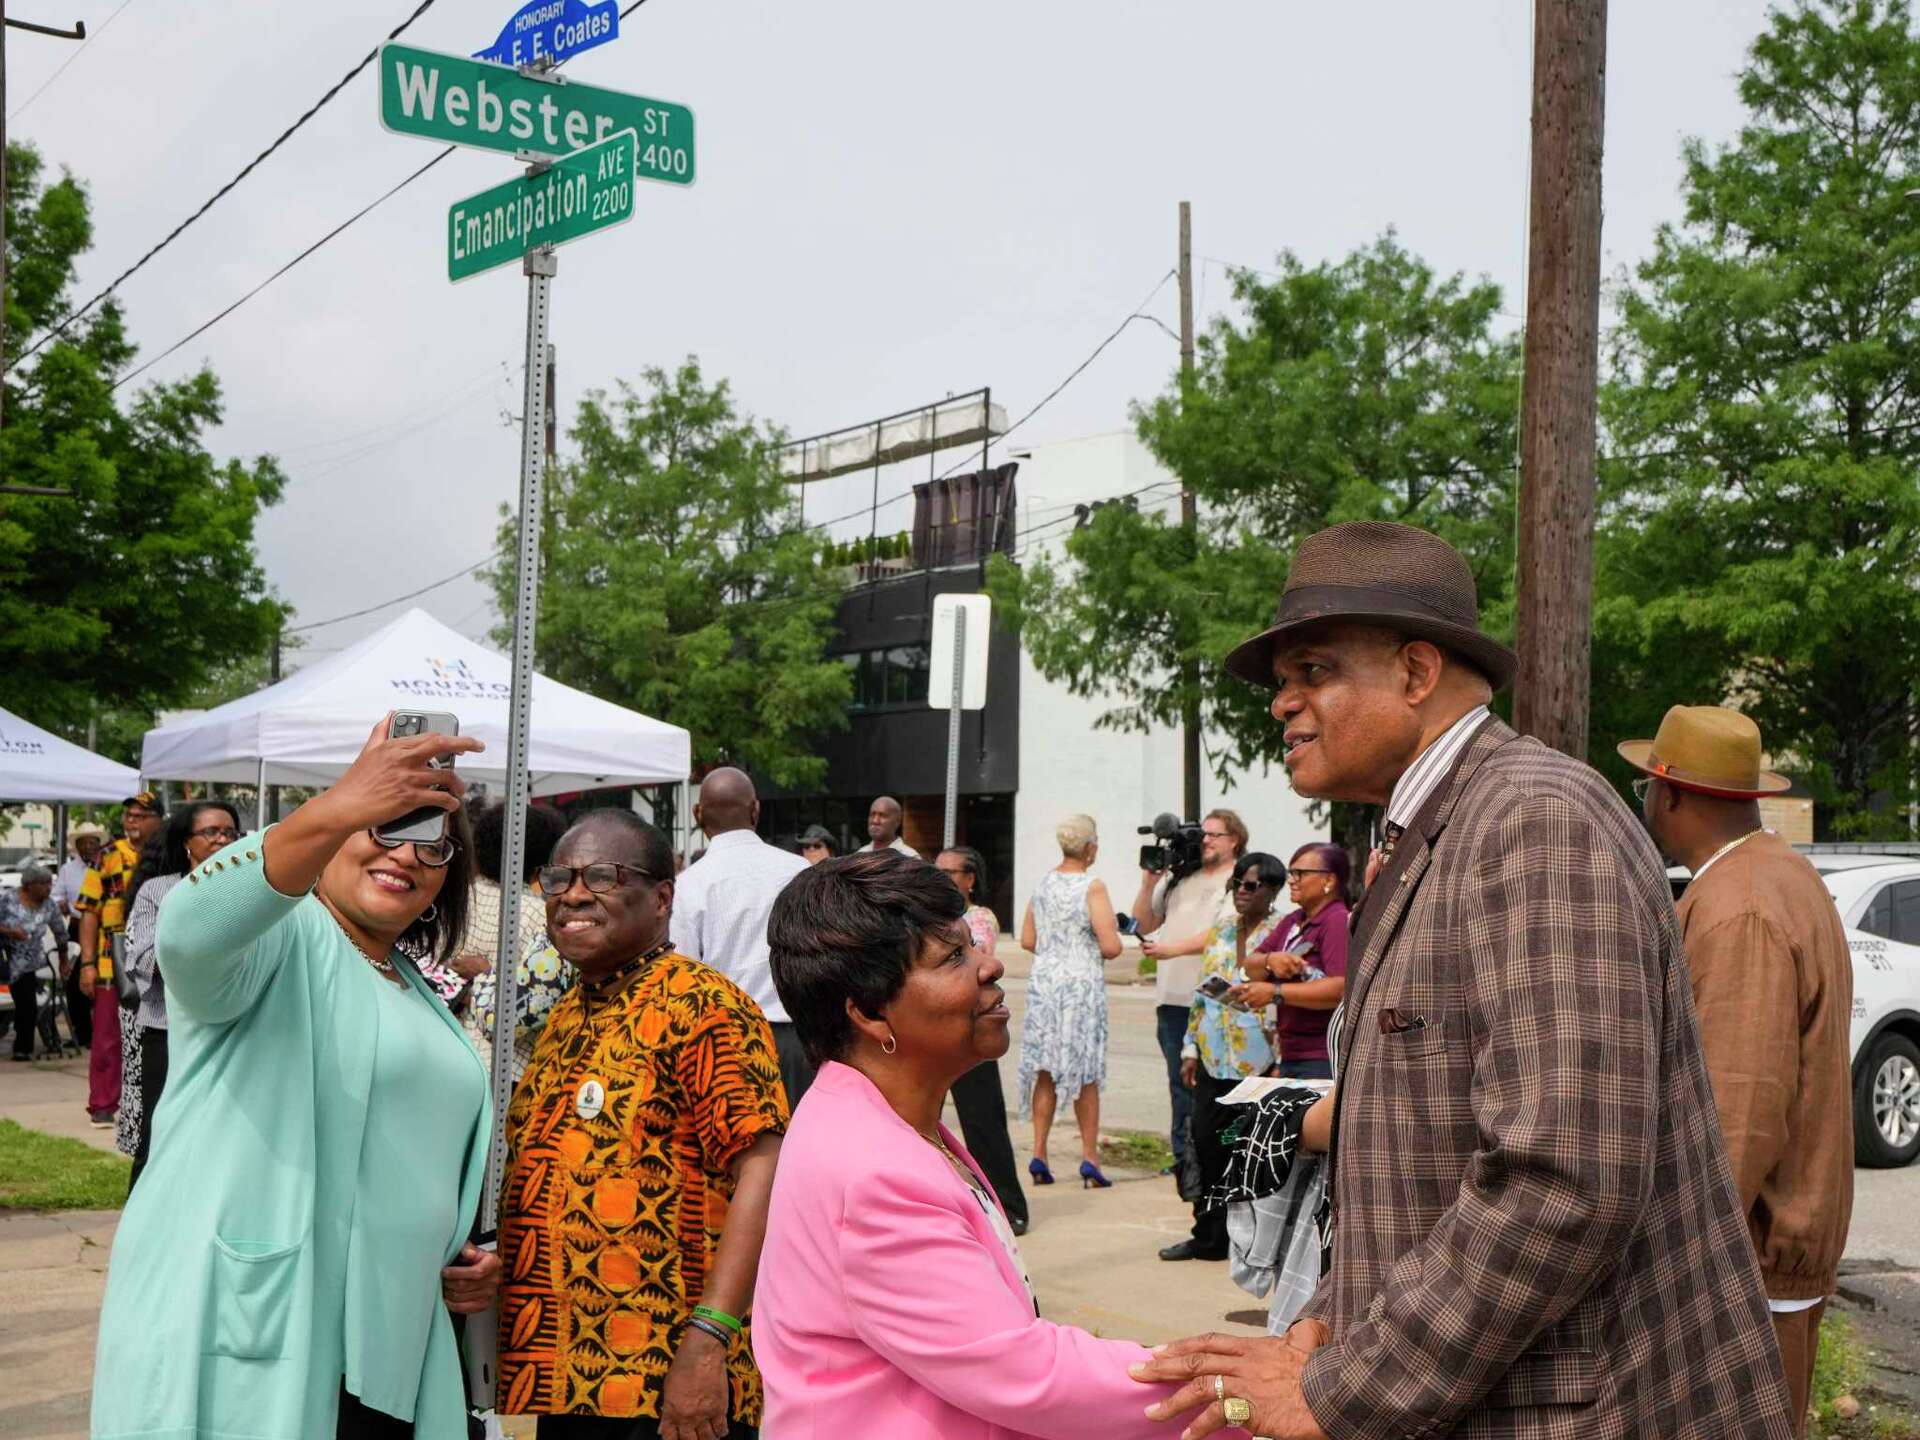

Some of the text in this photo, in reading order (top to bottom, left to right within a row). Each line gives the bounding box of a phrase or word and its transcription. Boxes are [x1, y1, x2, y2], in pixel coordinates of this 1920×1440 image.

[515, 1, 565, 33] HONORARY
[554, 11, 610, 51] Coates
[395, 61, 614, 149] Webster
[643, 107, 671, 137] ST
[597, 145, 625, 182] AVE
[636, 142, 687, 175] 400
[453, 172, 588, 260] Emancipation
[592, 181, 629, 221] 2200
[390, 679, 512, 693] HOUSTO
[2, 740, 43, 748] TON
